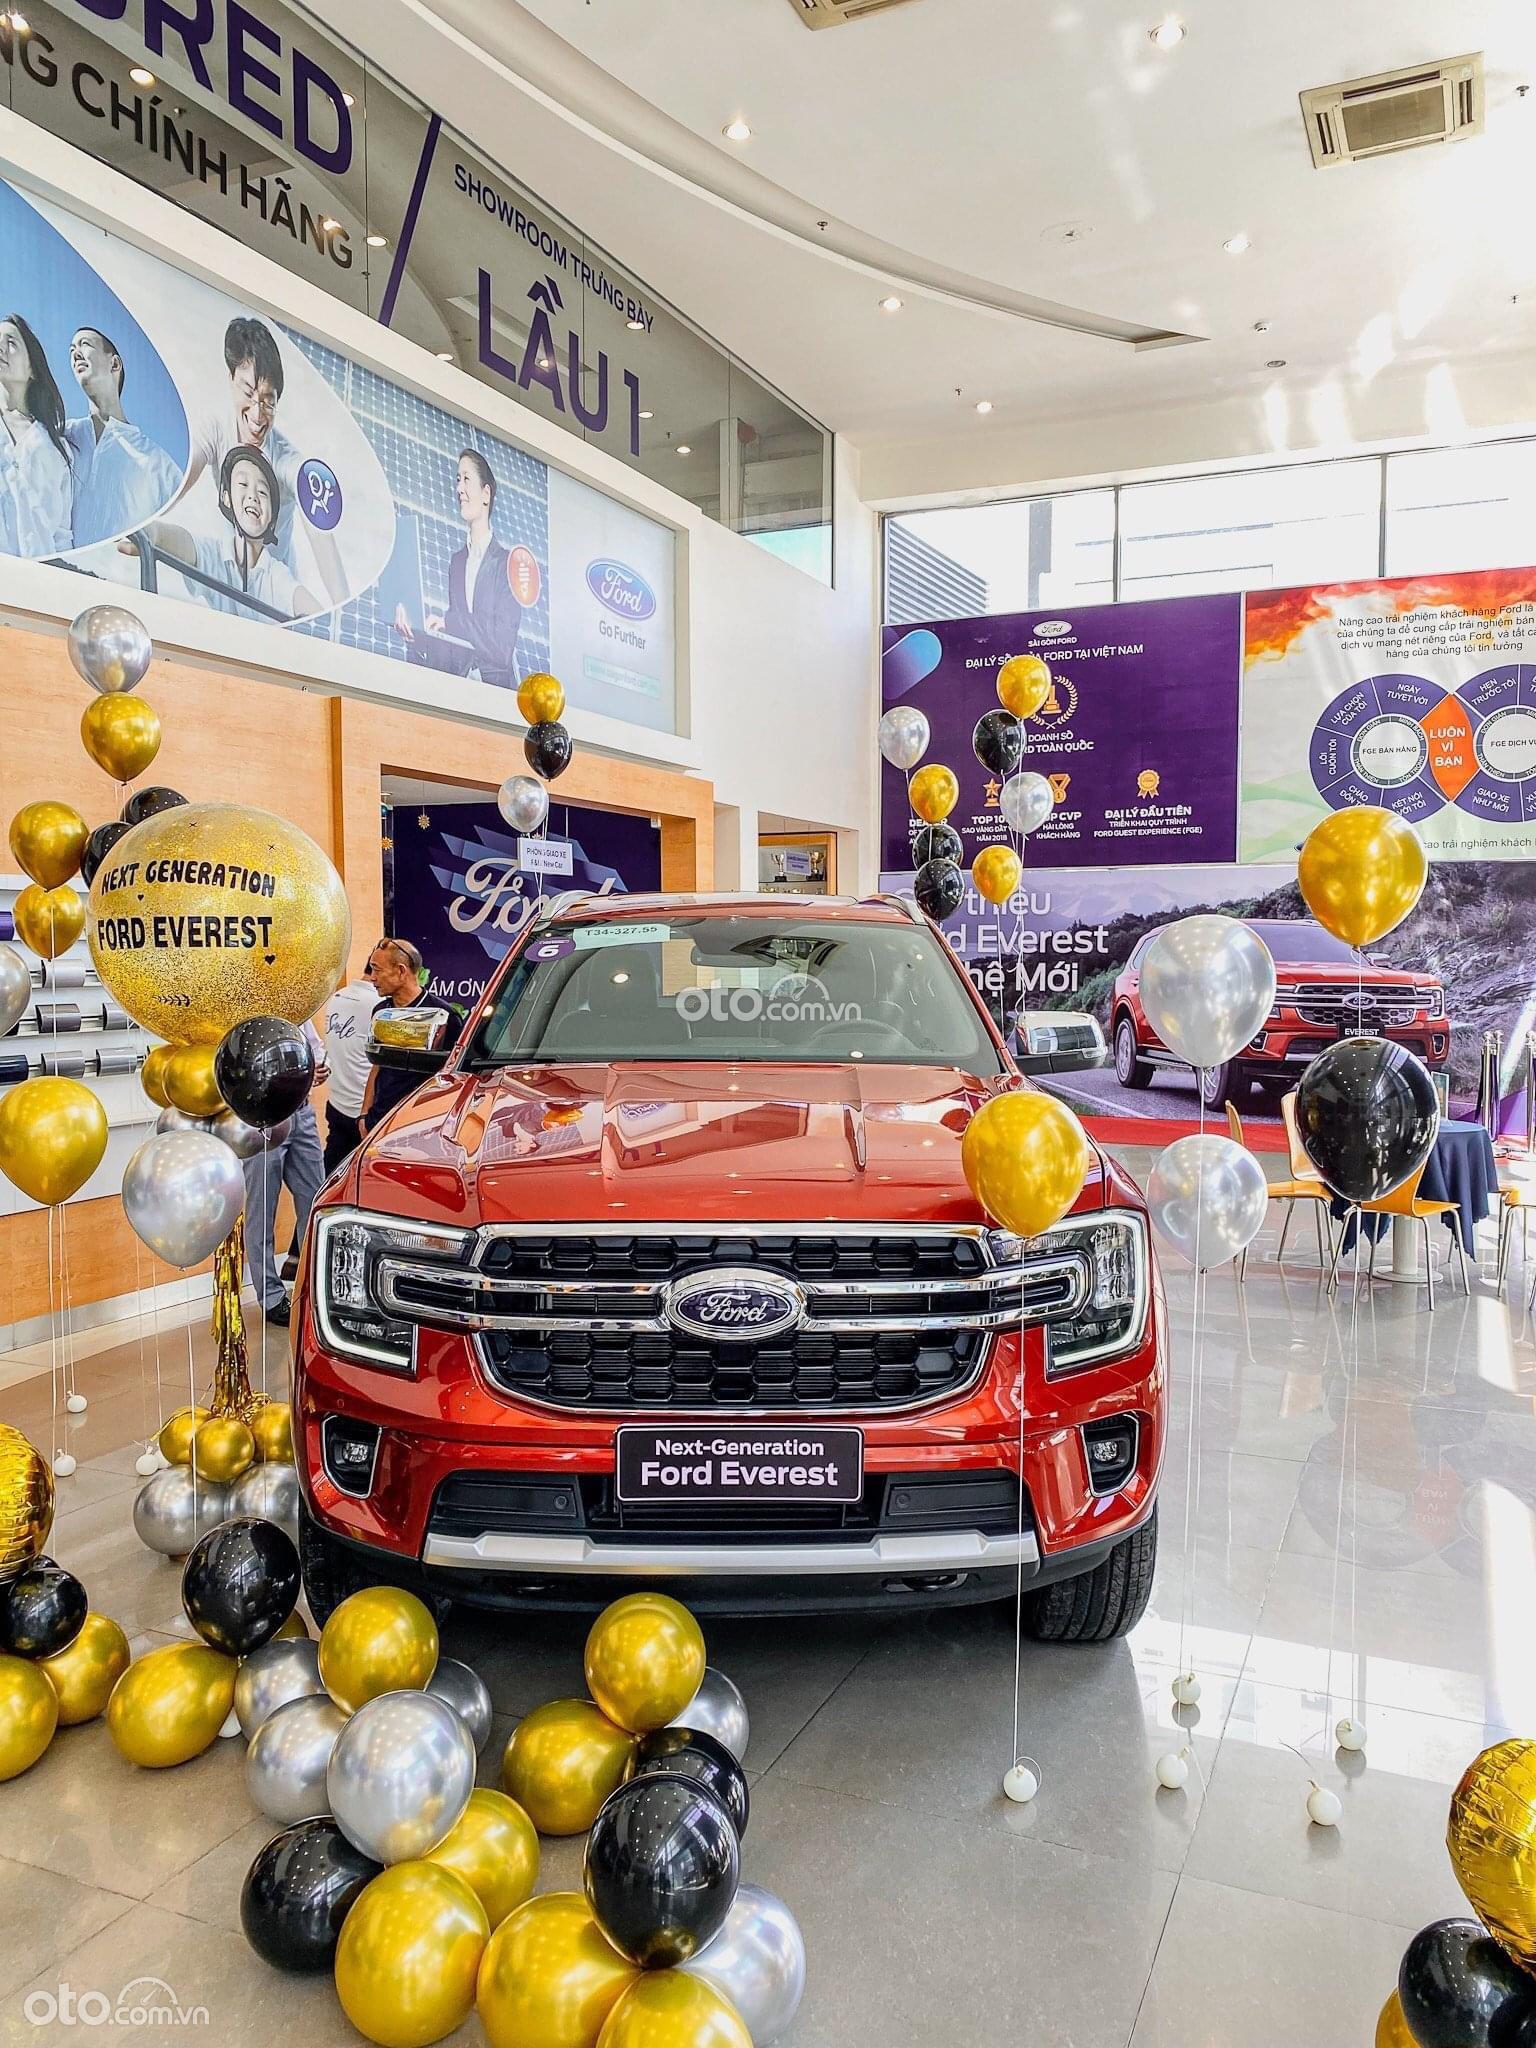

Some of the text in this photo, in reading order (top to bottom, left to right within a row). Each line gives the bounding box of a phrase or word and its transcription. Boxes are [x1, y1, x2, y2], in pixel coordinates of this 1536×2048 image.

[75, 0, 353, 175] RED
[71, 61, 353, 270] CHÍNH HÃNG
[454, 163, 654, 333] SHOWROOM TRƯNG BÀY
[478, 266, 640, 457] LẦU 1
[600, 567, 643, 612] Ford
[1339, 603, 1534, 627] Nâng cao trải nghiệm khách hàng Ford là
[599, 620, 646, 650] Go Further
[1041, 623, 1063, 634] Ford
[1337, 616, 1535, 639] của chúng ta để cung cấp trải nghiệm bán
[1028, 636, 1078, 648] SÀI GÒN FORD
[1341, 641, 1360, 650] dịch
[1363, 641, 1374, 649] vụ
[1376, 639, 1402, 648] mang
[1405, 636, 1420, 645] nét
[1422, 635, 1446, 645] riêng
[1449, 633, 1466, 642] của
[1497, 630, 1509, 638] và
[1512, 627, 1525, 637] tất
[965, 658, 983, 669] ĐẠI
[984, 654, 997, 667] LÝ
[1043, 650, 1073, 662] FORD
[1074, 649, 1091, 661] TẠI
[1092, 645, 1117, 658] VIỆT
[1117, 644, 1144, 655] NAM
[1386, 641, 1523, 659] hàng của chúng tôi tin tưởng
[1397, 683, 1421, 695] NGÀY
[1471, 686, 1502, 706] TRƯỚC
[1387, 690, 1429, 706] TUYỆT VỜI
[1330, 692, 1365, 724] LỰA CHỌN
[1342, 700, 1368, 726] CỦA TÔI
[1028, 732, 1060, 742] DOANH
[1429, 726, 1466, 739] LUÔN
[1035, 742, 1063, 753] TOÀN
[1064, 739, 1095, 753] QUỐC
[1328, 738, 1337, 752] TÔI
[1378, 746, 1394, 754] BÁN
[1395, 745, 1417, 754] HÀNG
[1441, 740, 1454, 753] VÌ
[1434, 755, 1463, 769] BẠN
[1391, 791, 1423, 810] KẾT NỐI
[1477, 787, 1498, 799] GIAO
[1498, 792, 1511, 804] XE
[1105, 804, 1192, 820] ĐẠI LÝ ĐẦU TIÊN
[1411, 800, 1427, 811] TÔI
[1472, 796, 1510, 813] NHƯ MỚI
[971, 815, 994, 825] TOP
[1059, 811, 1082, 821] CVP
[1108, 817, 1188, 828] TRIỂN KHAI QUY TRÌNH
[976, 825, 994, 833] VÀNG
[1042, 821, 1075, 831] HÀI LÒNG
[1094, 826, 1203, 838] FORD GUEST EXPERIENCE (FGE)
[976, 834, 992, 842] NĂM
[1036, 830, 1081, 840] KHÁCH HÀNG
[1442, 839, 1458, 849] trải
[1461, 838, 1498, 850] nghiệm
[1501, 838, 1532, 847] khách
[101, 859, 276, 898] NEXT GENERATION
[97, 915, 273, 951] FORD EVEREST
[977, 923, 1109, 954] Everest
[537, 944, 560, 958] 6
[1015, 961, 1079, 992] Mới
[457, 978, 486, 997] ƠN
[1344, 1028, 1380, 1036] EVEREST
[700, 1292, 769, 1323] Ford
[655, 1438, 825, 1456] Next-Generation
[640, 1460, 839, 1486] Ford Everest
